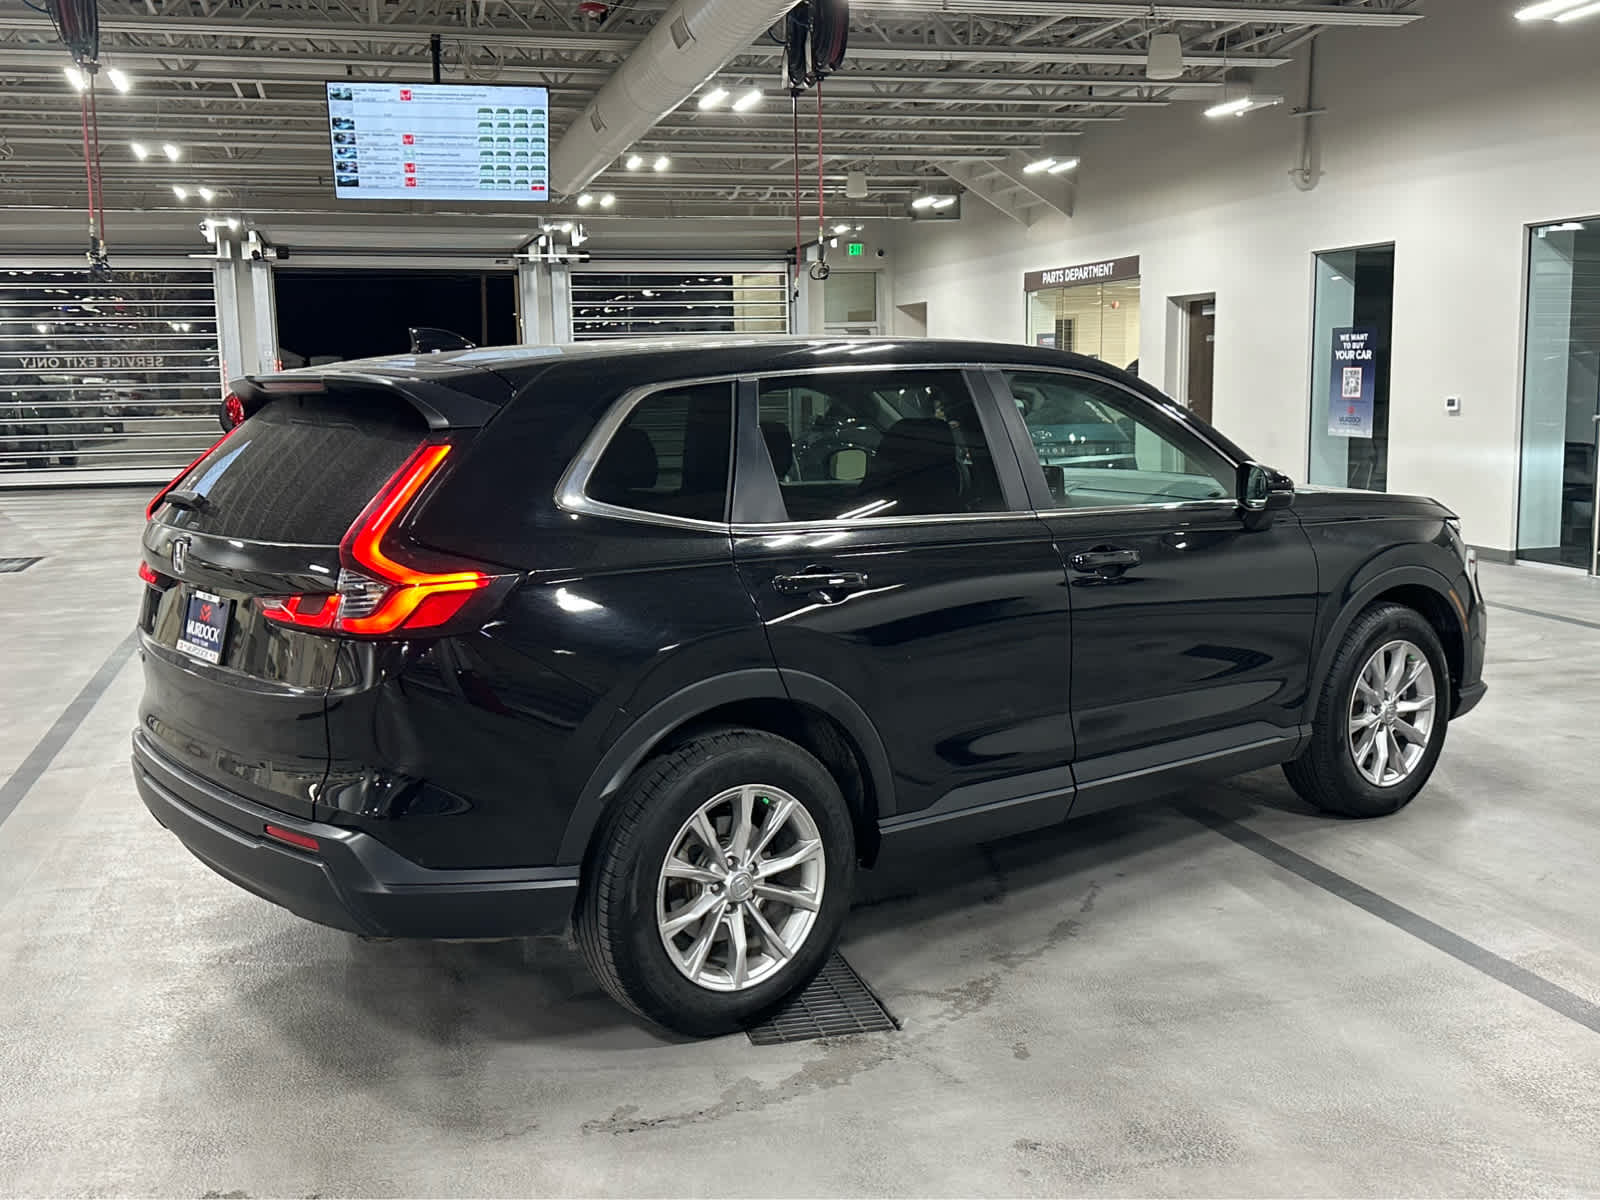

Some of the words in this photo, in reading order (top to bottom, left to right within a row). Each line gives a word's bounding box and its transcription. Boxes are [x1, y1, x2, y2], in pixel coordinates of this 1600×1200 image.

[1042, 269, 1064, 285] PARTS
[1064, 262, 1115, 282] DEPARTMENT
[1340, 333, 1350, 341] WE
[1351, 333, 1368, 341] WANT
[1335, 350, 1355, 360] YOUR
[1356, 350, 1372, 360] CAR
[186, 619, 220, 643] MURDOCK
